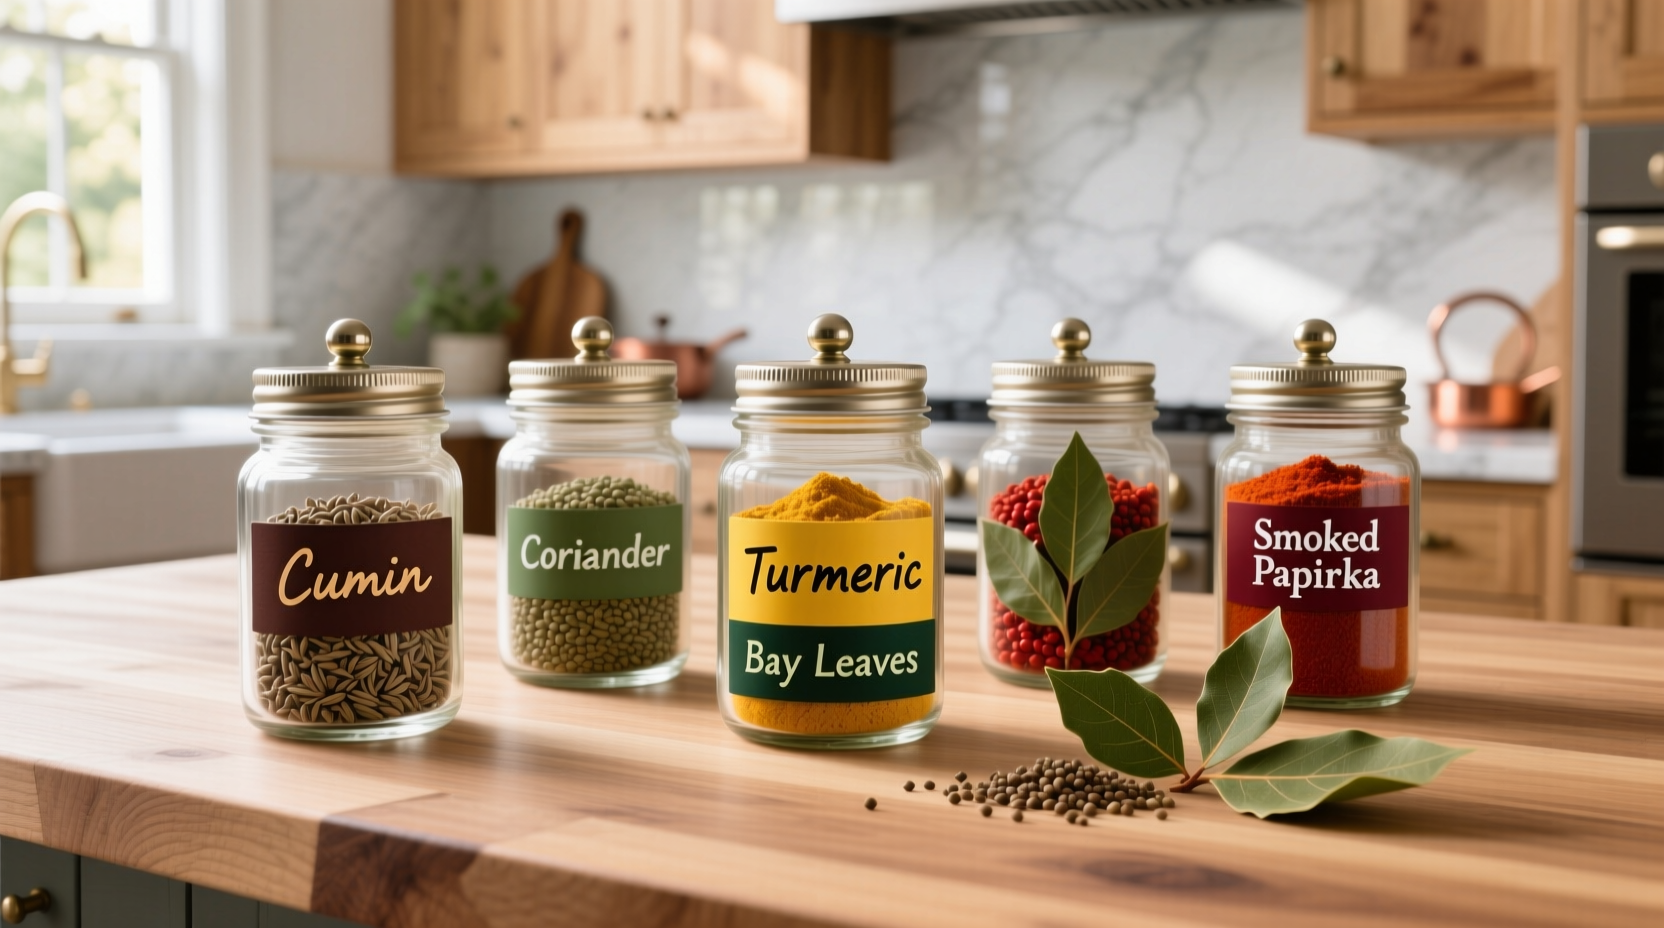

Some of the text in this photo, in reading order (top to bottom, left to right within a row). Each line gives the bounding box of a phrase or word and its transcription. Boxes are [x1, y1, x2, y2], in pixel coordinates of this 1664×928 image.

[520, 532, 671, 571] Coriander
[1253, 517, 1380, 552] Smoked
[278, 547, 433, 606] Cumin
[744, 545, 922, 595] Turmeric
[1252, 554, 1381, 599] Papirka
[744, 639, 919, 688] Bay Leaves
